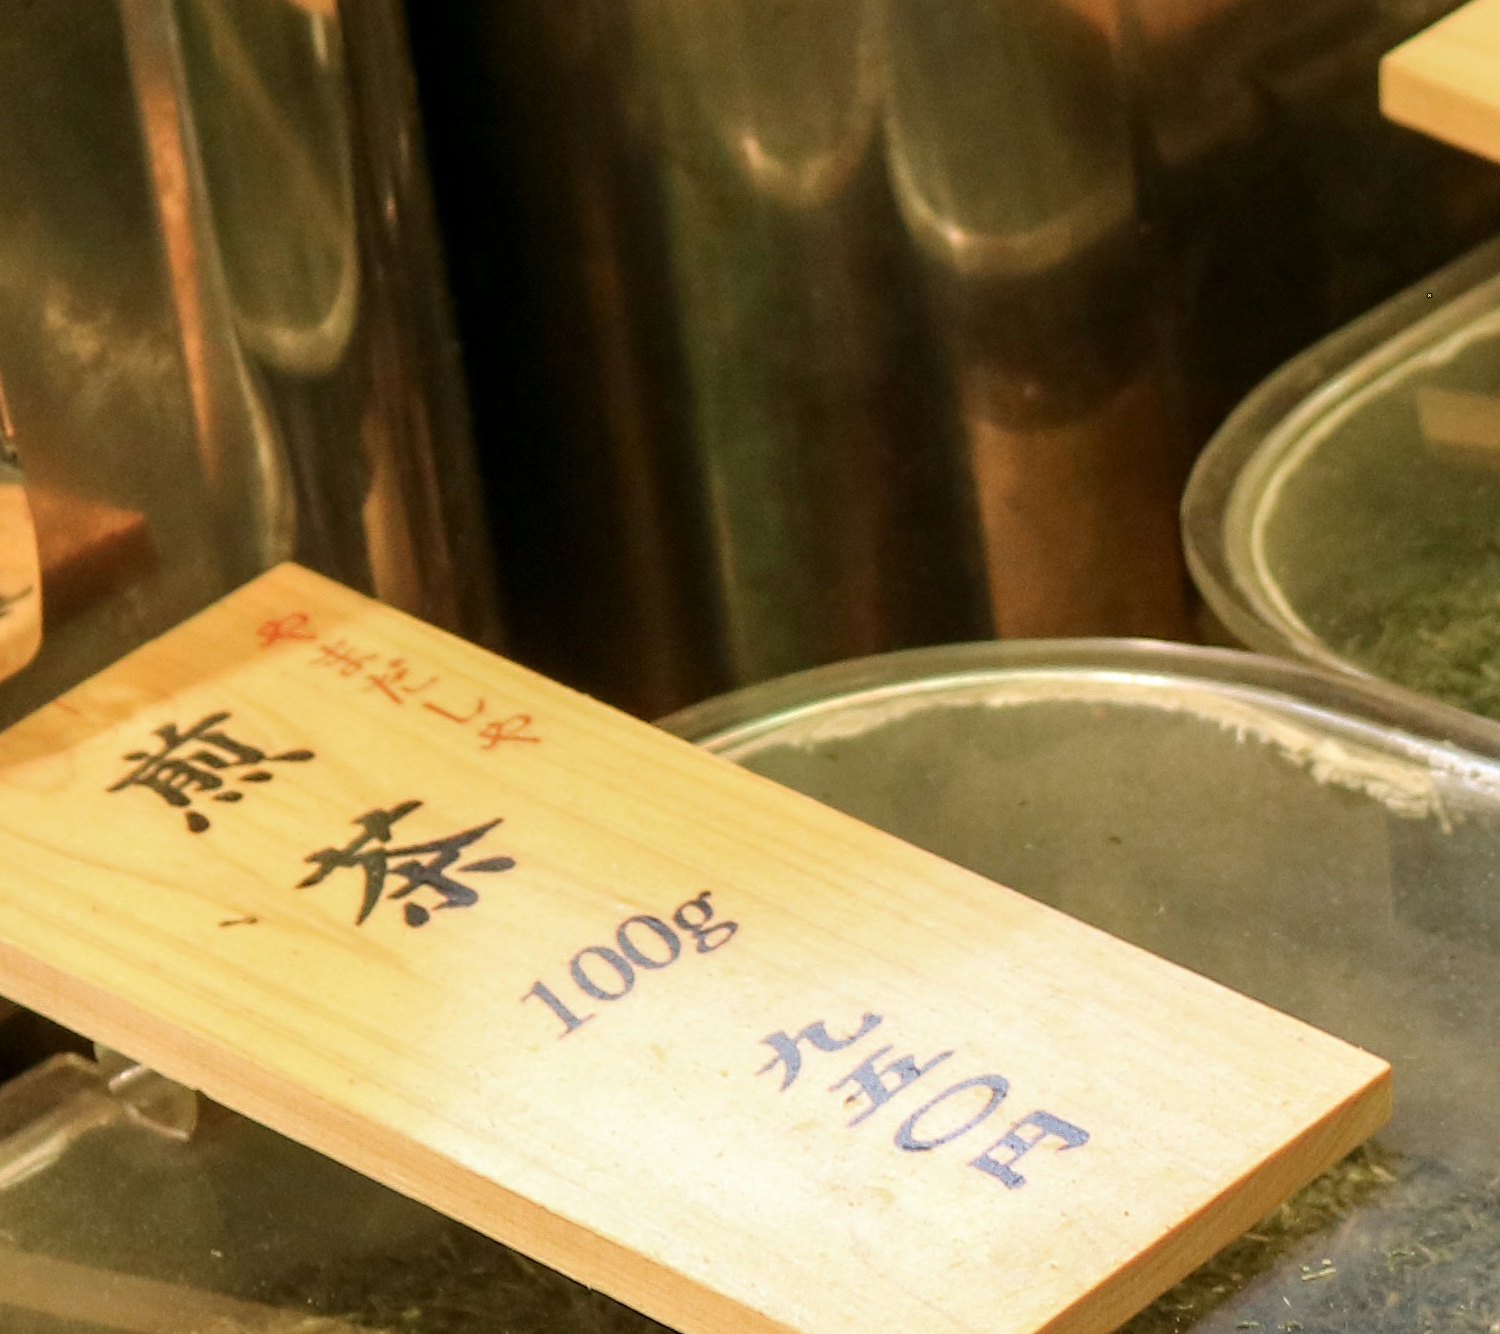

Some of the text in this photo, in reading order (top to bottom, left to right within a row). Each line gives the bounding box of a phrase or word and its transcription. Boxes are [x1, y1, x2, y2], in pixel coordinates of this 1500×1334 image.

[255, 611, 543, 751] やまだしや
[105, 710, 517, 928] 煎茶
[517, 888, 740, 1041] 100g
